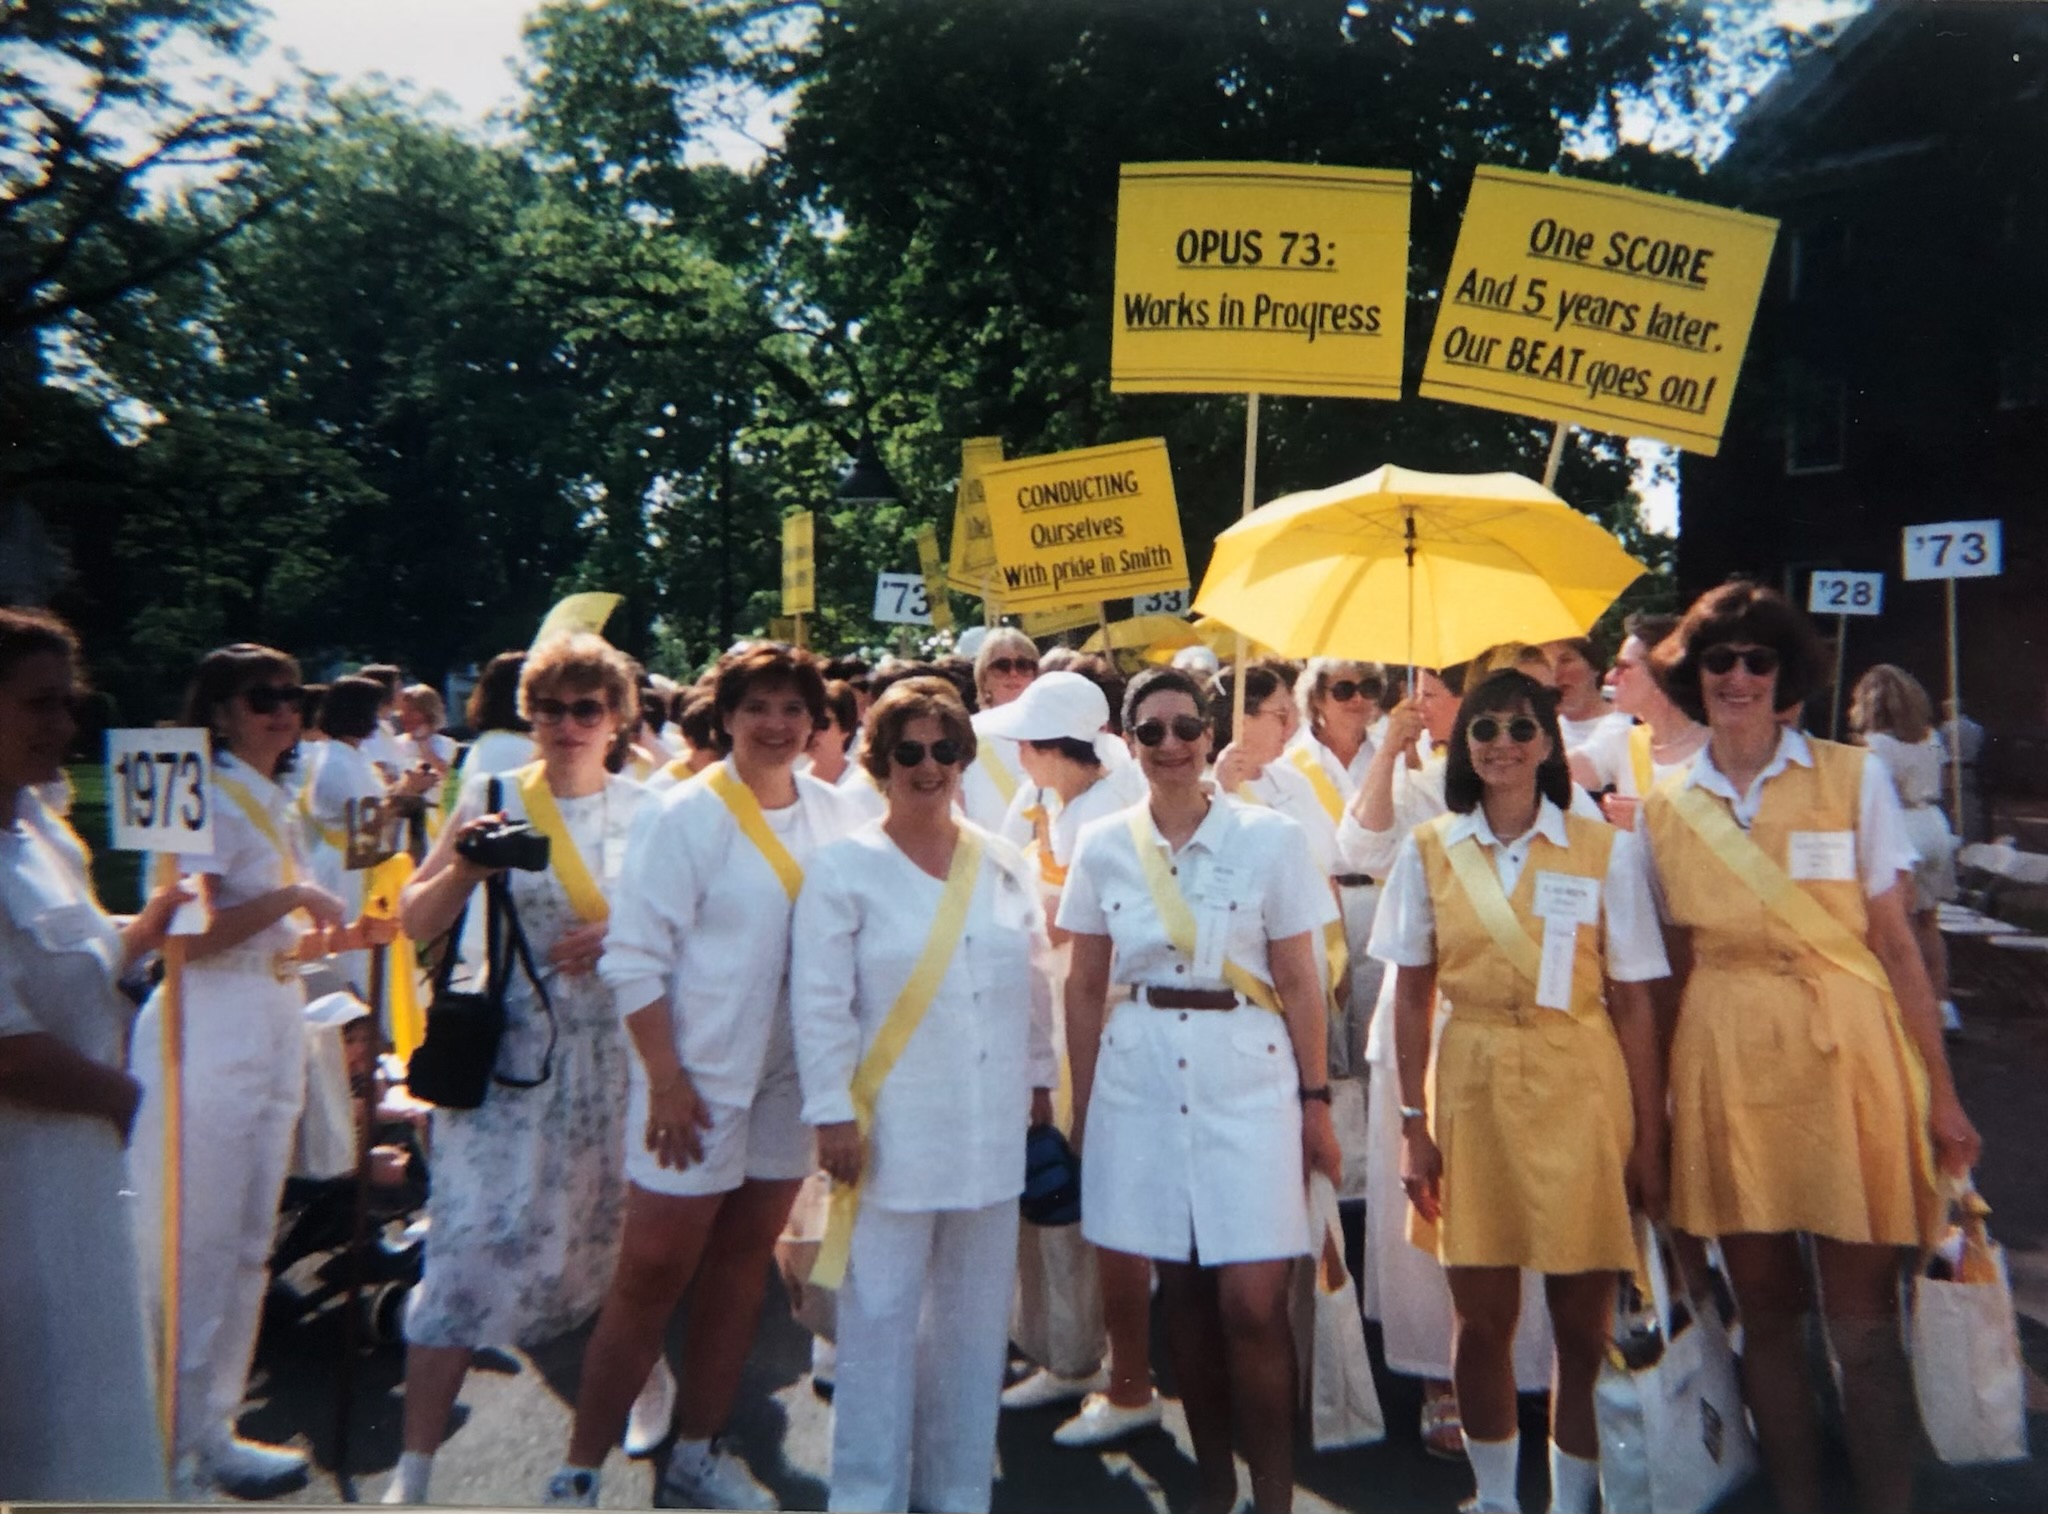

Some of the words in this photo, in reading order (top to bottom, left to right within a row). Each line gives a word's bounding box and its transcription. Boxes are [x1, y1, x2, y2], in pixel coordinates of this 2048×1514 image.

[1176, 229, 1263, 265] OPUS
[1279, 232, 1336, 267] 73:
[1530, 219, 1594, 260] One
[1604, 231, 1714, 285] SCORE
[1124, 292, 1210, 327] Works
[1219, 292, 1244, 327] in
[1254, 293, 1381, 343] Progress
[1456, 267, 1518, 307] And
[1522, 279, 1547, 313] 5
[1555, 289, 1640, 331] years
[1444, 326, 1502, 362] Our
[1505, 336, 1585, 384] BEAT
[1585, 359, 1652, 400] goes
[1660, 375, 1717, 415] on!
[1017, 470, 1138, 509] CONDUCTING
[1031, 515, 1124, 547] Ourselves
[1915, 532, 1988, 566] '73
[1003, 562, 1048, 588] With
[1052, 554, 1095, 591] pride
[1100, 552, 1116, 577] in
[1119, 543, 1172, 572] Smith
[114, 750, 205, 831] 1973
